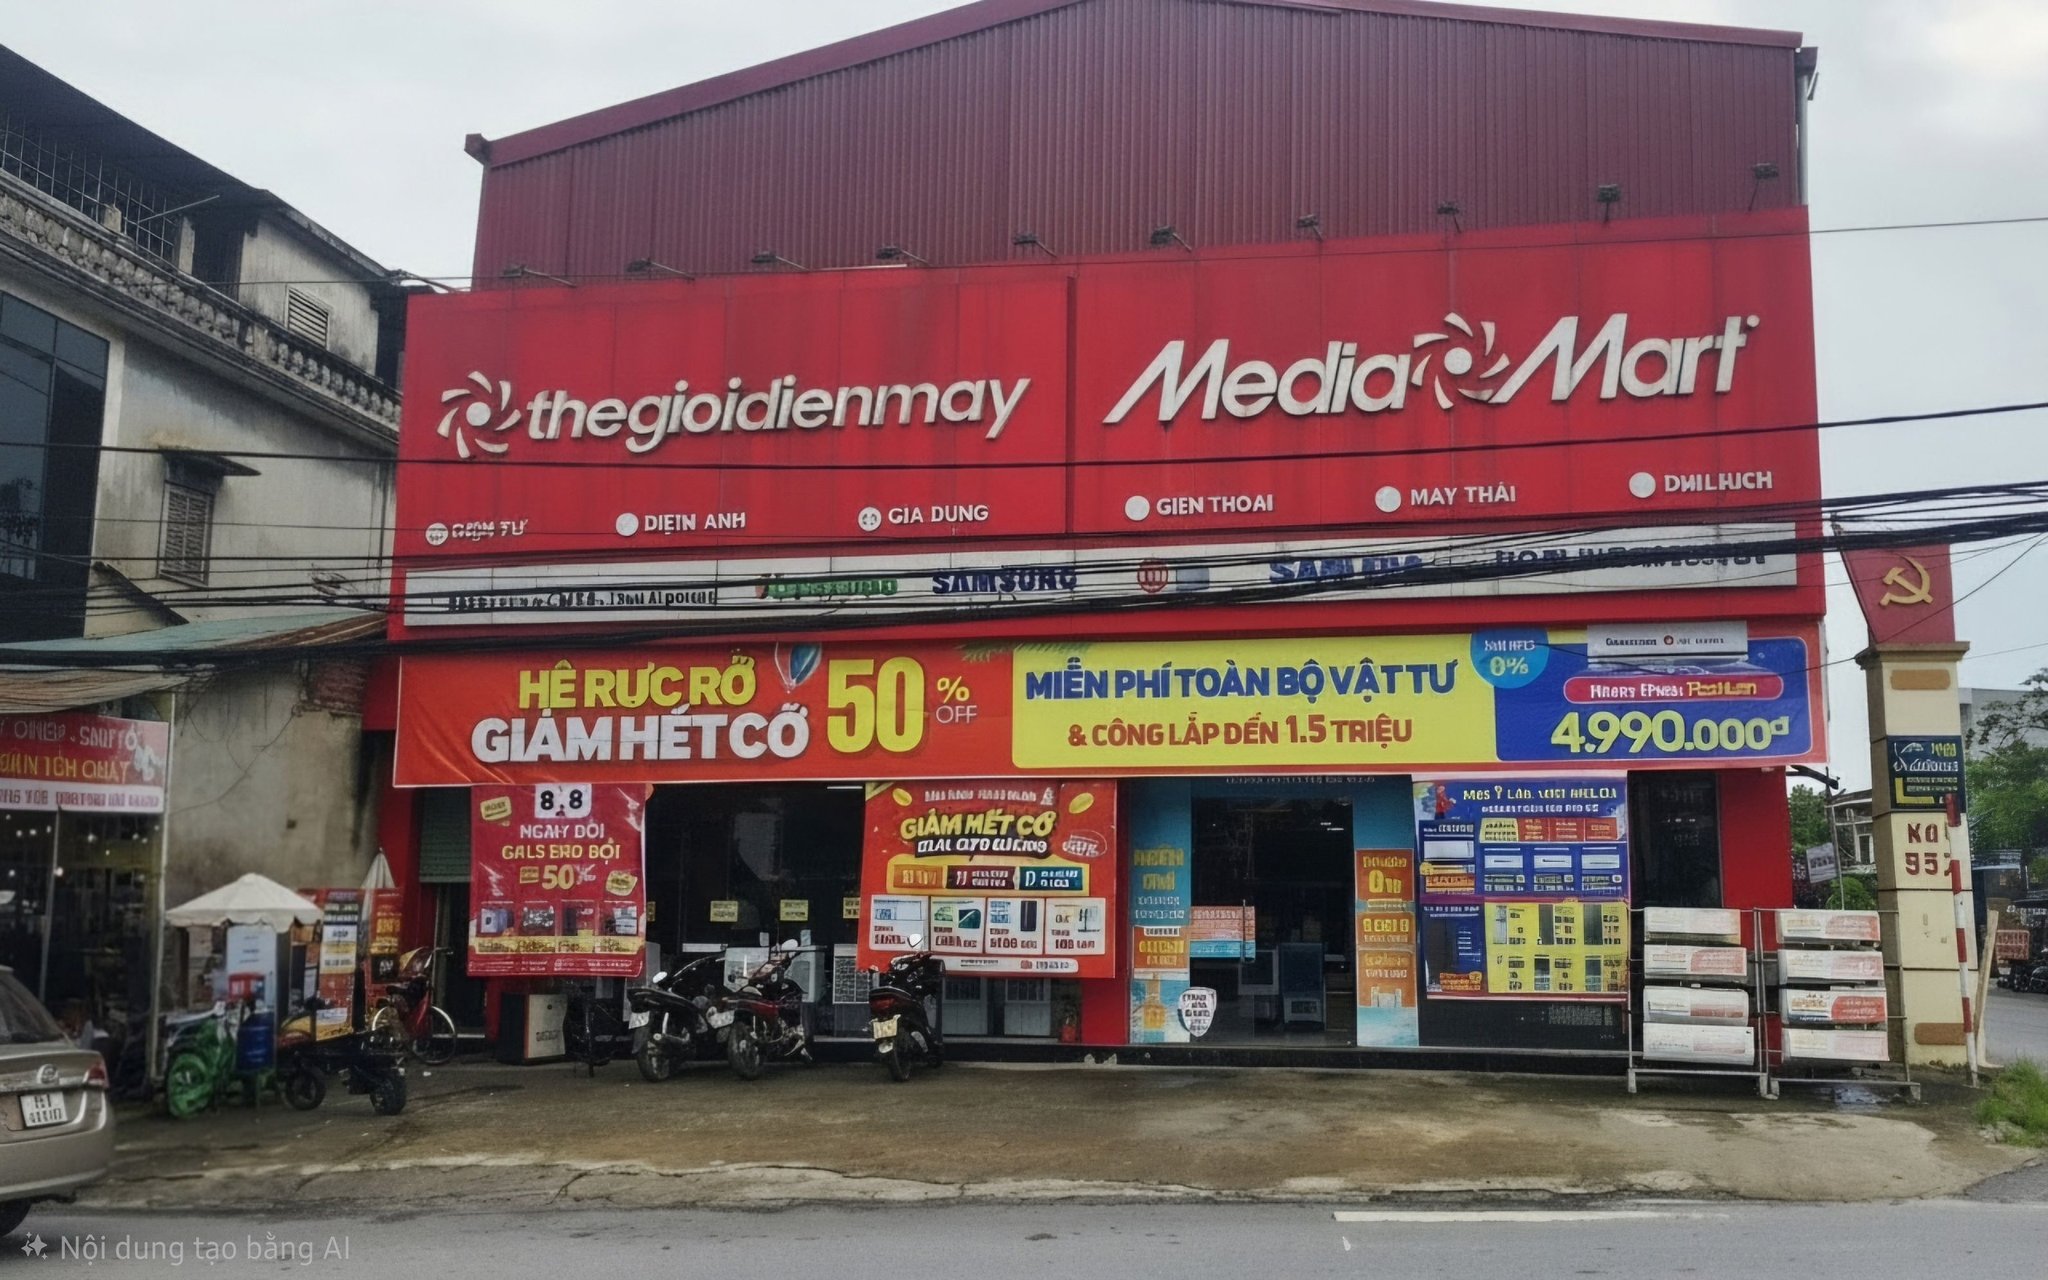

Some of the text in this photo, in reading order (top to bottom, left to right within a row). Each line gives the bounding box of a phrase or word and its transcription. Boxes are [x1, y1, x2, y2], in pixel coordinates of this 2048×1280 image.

[1102, 312, 1762, 425] Media Mart
[526, 375, 1032, 454] thegioidienmay
[1156, 494, 1273, 516] GIEN THOAI
[1411, 485, 1456, 506] MAY
[704, 511, 746, 530] ANH
[888, 504, 989, 525] GIA DUNG
[1114, 661, 1173, 699] PHÍ
[1174, 658, 1270, 698] TOÀN
[1276, 658, 1325, 704] BỘ
[1329, 656, 1404, 703] VẬT
[1405, 658, 1459, 694] TƯ
[827, 656, 970, 753] 50 %
[936, 704, 978, 724] OFF
[1067, 724, 1087, 747] &
[1092, 717, 1164, 746] CÔNG
[1285, 714, 1327, 743] 1.5
[1330, 712, 1413, 749] TRIỆU
[541, 863, 575, 890] 50
